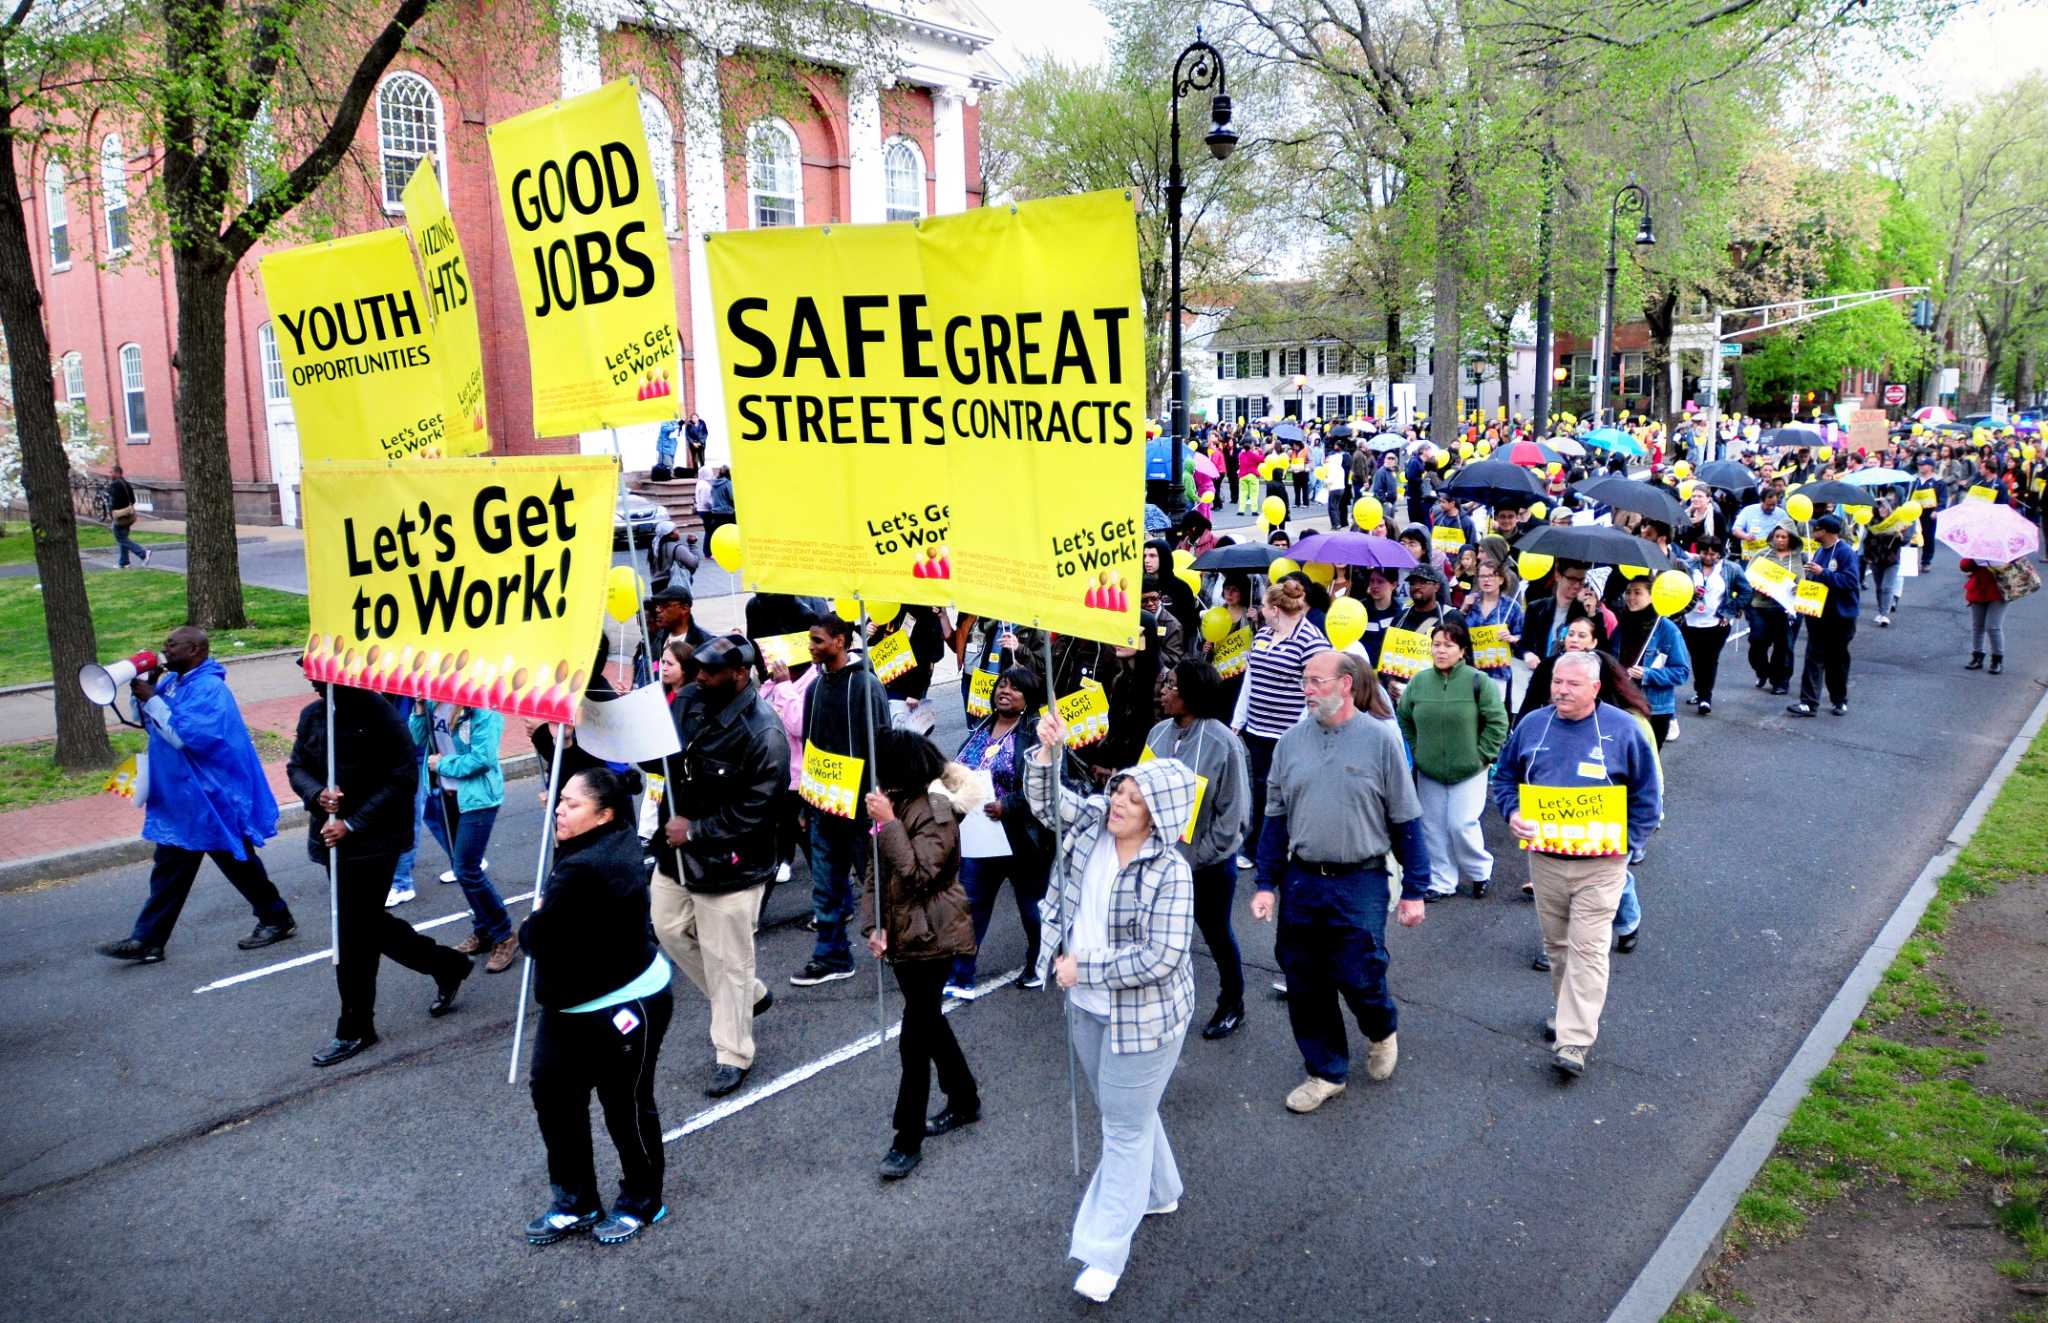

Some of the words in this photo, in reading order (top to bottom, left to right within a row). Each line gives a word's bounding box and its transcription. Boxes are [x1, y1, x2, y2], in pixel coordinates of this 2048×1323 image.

[512, 141, 639, 231] GOOD
[534, 221, 656, 317] JOBS
[278, 289, 421, 356] YOUTH
[727, 293, 939, 379] SAFE
[292, 345, 430, 386] OPPORTUNITIES
[605, 343, 640, 370] Let's
[644, 324, 671, 347] Get
[612, 371, 628, 386] to
[629, 339, 674, 375] Work!
[944, 307, 1129, 386] GREAT
[381, 428, 415, 450] Let's
[418, 414, 443, 431] Get
[738, 395, 946, 446] STREETS
[951, 398, 1133, 446] CONTRACTS
[388, 449, 403, 460] to
[403, 424, 445, 453] Work!
[343, 501, 457, 578] Let's
[473, 474, 577, 555] Get
[867, 511, 919, 538] Let's
[924, 504, 950, 522] Ge
[874, 539, 898, 555] to
[900, 522, 950, 549] Wor
[1051, 530, 1095, 556] Let's
[1100, 517, 1137, 541] Get
[1055, 560, 1076, 579] to
[1077, 539, 1138, 570] Work!
[352, 584, 399, 642] to
[408, 547, 572, 636] Work!
[1063, 701, 1093, 722] Work!
[1071, 694, 1089, 708] Get
[814, 767, 842, 781] Work!
[822, 758, 842, 770] Get
[1538, 797, 1572, 809] Let's
[1577, 793, 1603, 805] Get
[1541, 812, 1556, 821] to
[1558, 804, 1604, 820] Work!
